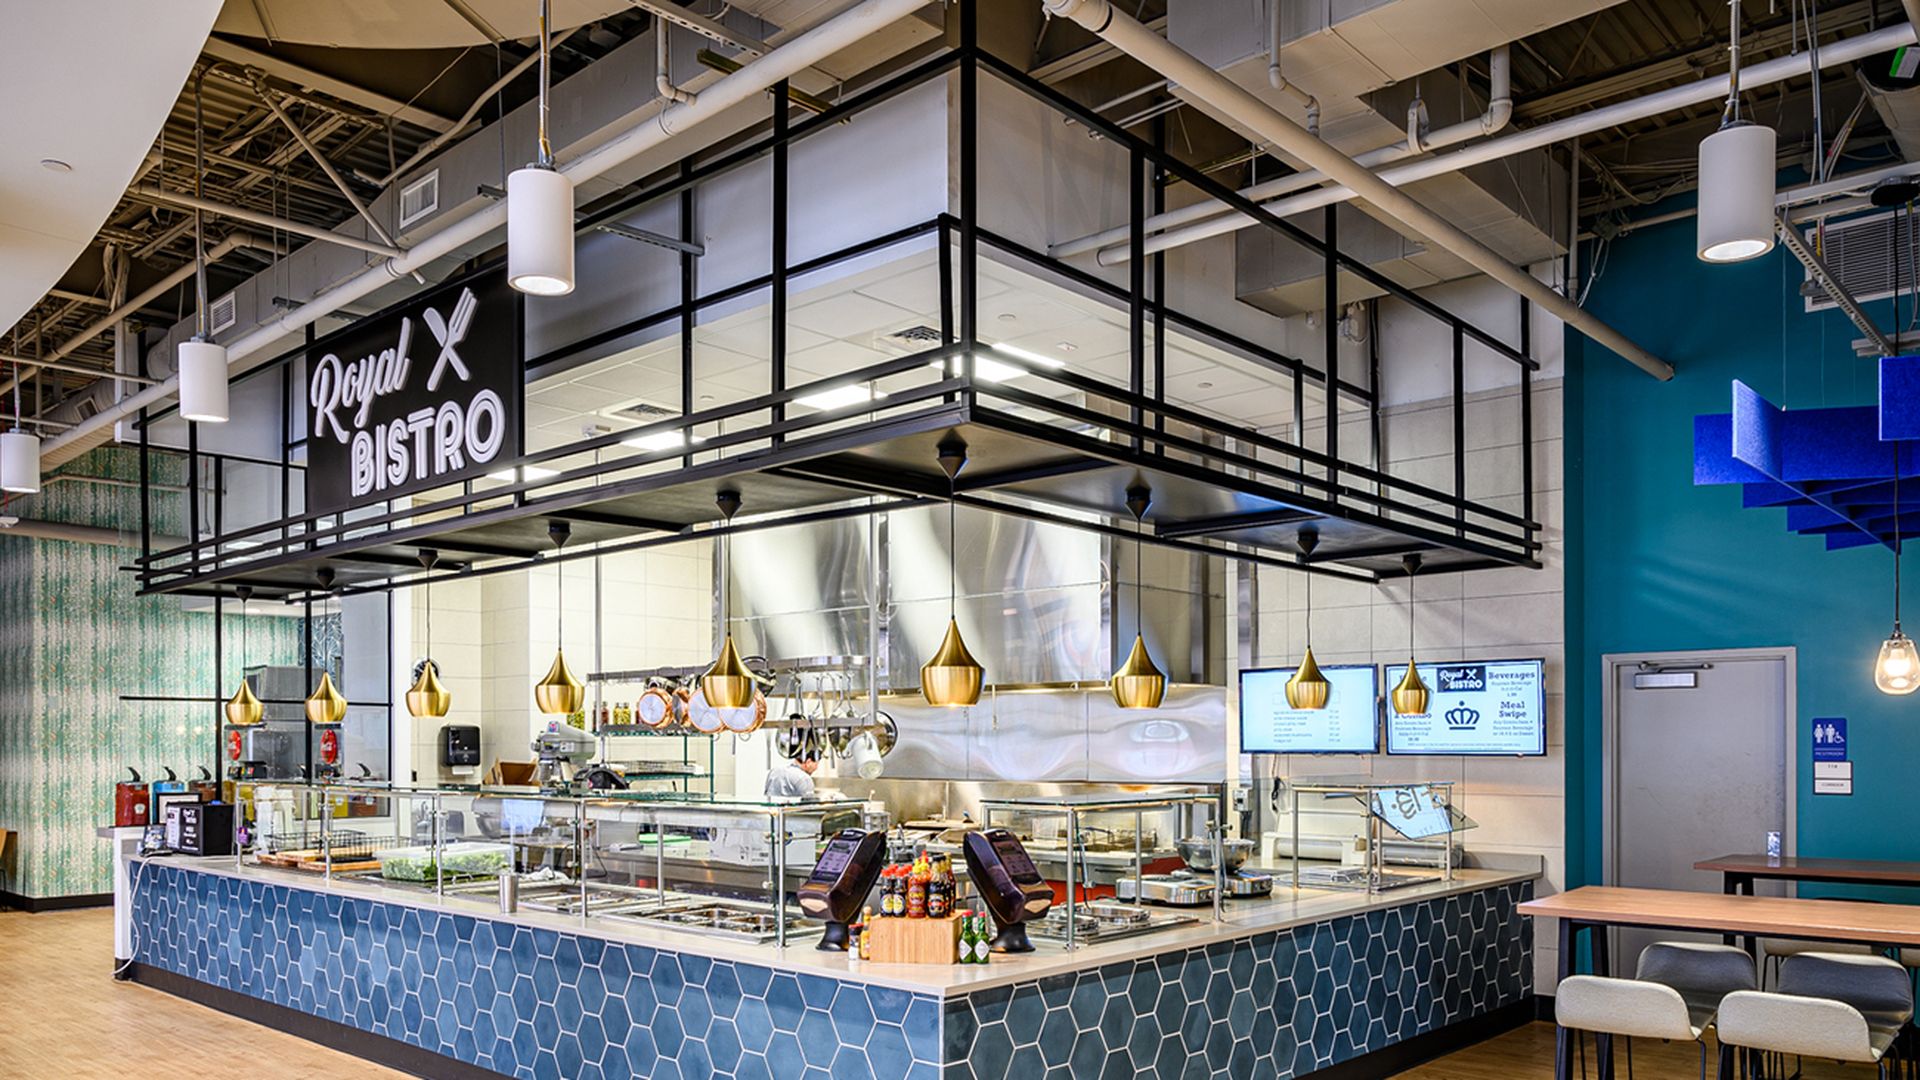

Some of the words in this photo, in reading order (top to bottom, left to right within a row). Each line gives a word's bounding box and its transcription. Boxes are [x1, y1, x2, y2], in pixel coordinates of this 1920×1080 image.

[310, 316, 413, 444] Royal
[351, 389, 506, 498] BISTRO
[1439, 668, 1464, 683] Royal
[1488, 671, 1536, 681] Beverages
[1449, 679, 1484, 690] BISTRO
[1500, 700, 1525, 709] Meal
[1498, 710, 1527, 720] Swipe
